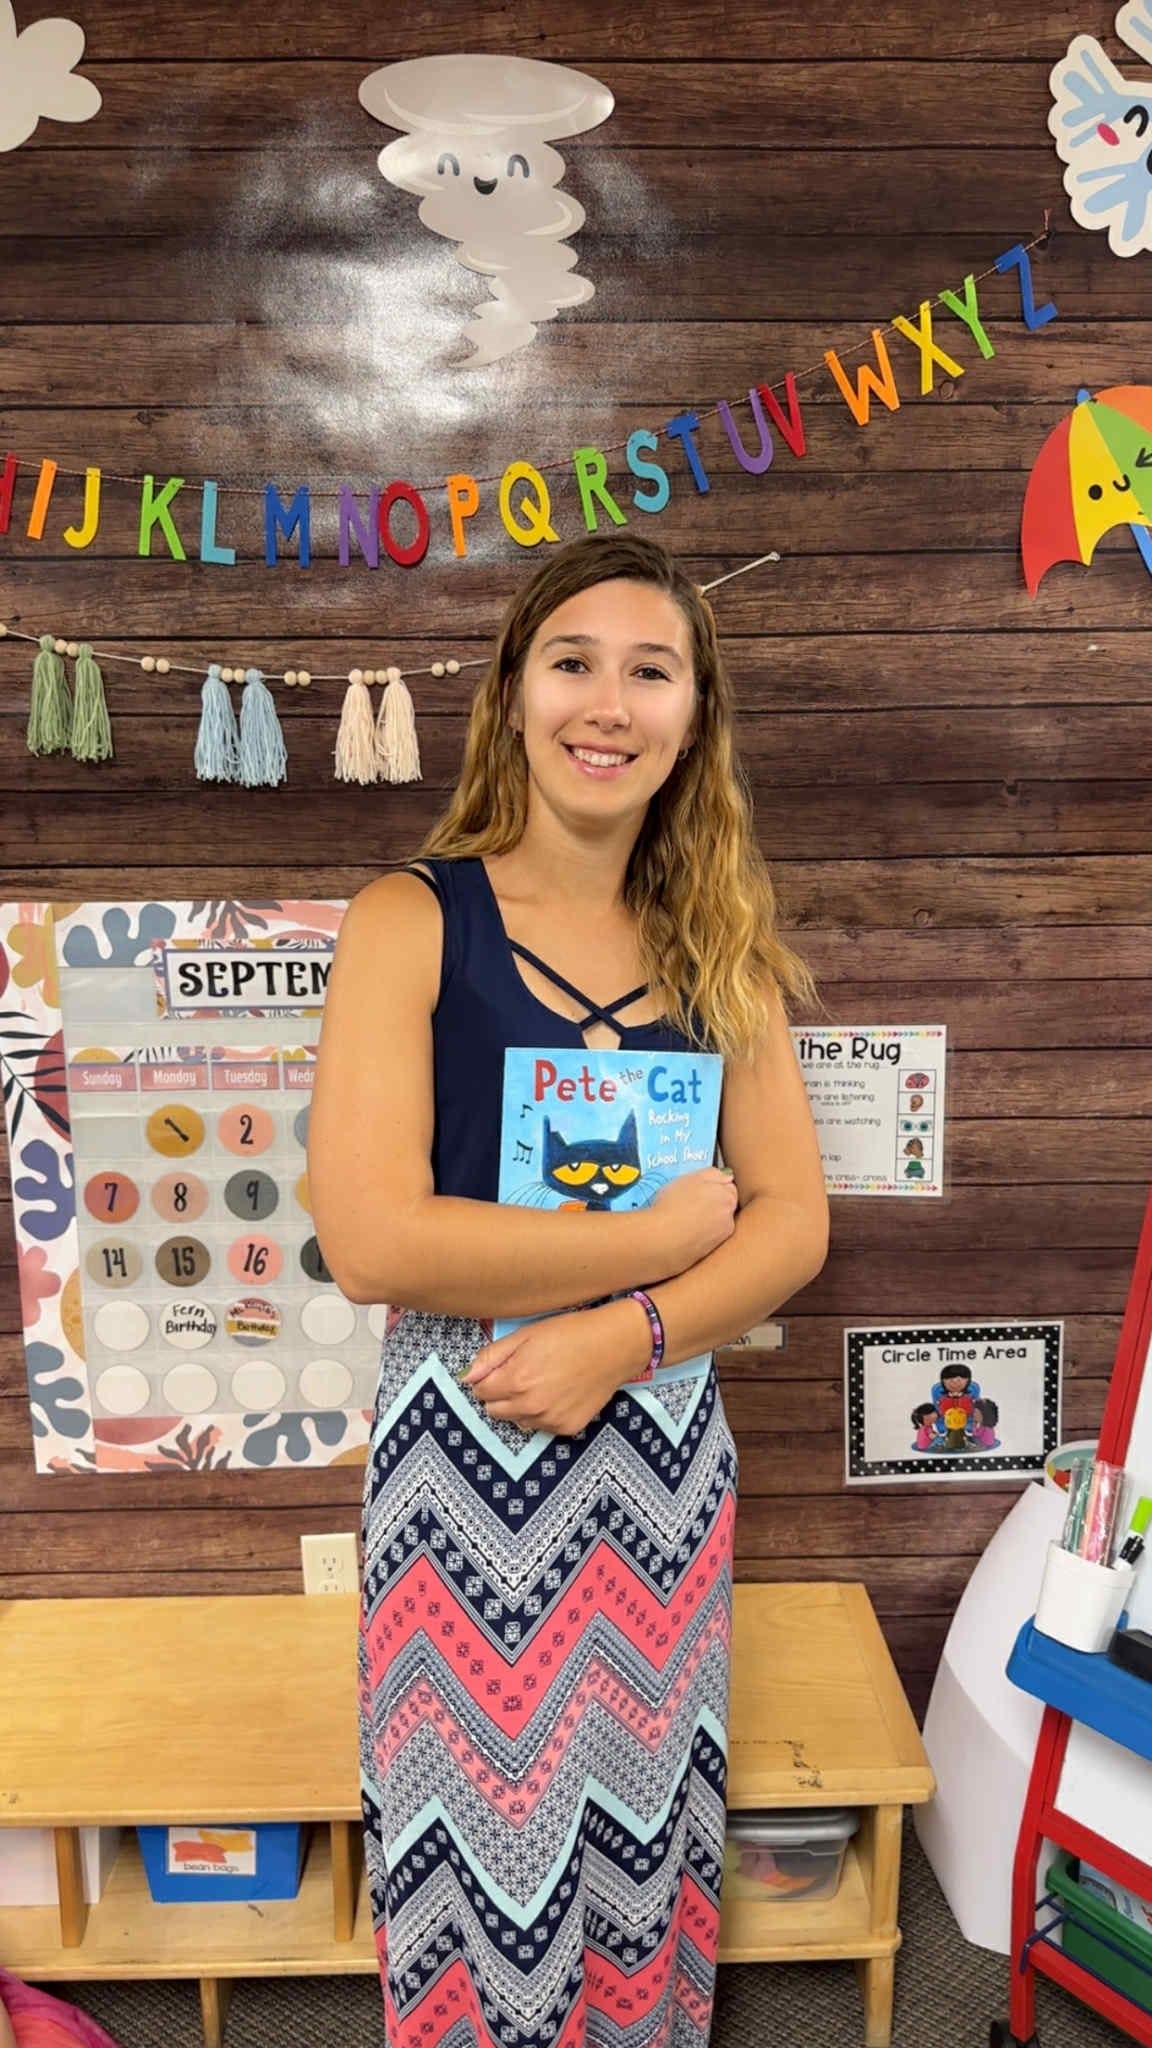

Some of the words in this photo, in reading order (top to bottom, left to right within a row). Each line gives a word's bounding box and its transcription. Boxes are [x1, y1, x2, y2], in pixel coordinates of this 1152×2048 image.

[27, 458, 57, 540] I
[64, 468, 101, 549] J
[139, 475, 186, 560] K
[202, 480, 235, 565] L
[265, 483, 310, 567] M
[339, 485, 380, 568] N
[378, 480, 430, 567] O
[447, 473, 479, 557] P
[499, 461, 560, 547] Q
[573, 447, 628, 531] R
[626, 429, 670, 514] S
[667, 413, 710, 494] T
[718, 388, 773, 475] U
[758, 372, 806, 457] V
[824, 329, 900, 426] W
[891, 301, 965, 395] X
[938, 274, 994, 360] Y
[994, 244, 1059, 331] Z
[799, 1038, 843, 1061] the
[852, 1037, 901, 1065] Rug
[846, 1061, 862, 1069] the
[82, 1071, 122, 1087] Sunday
[153, 1070, 196, 1086] Monday
[224, 1069, 268, 1086] Tuesday
[532, 1059, 618, 1103] Pete
[619, 1067, 644, 1086] the
[647, 1066, 702, 1104] Cat
[833, 1080, 866, 1089] thinking
[841, 1093, 875, 1102] listening
[648, 1108, 690, 1128] Rocking
[844, 1117, 882, 1127] watching
[164, 1118, 190, 1142] 1
[240, 1114, 253, 1145] 2
[648, 1148, 677, 1168] School
[104, 1182, 118, 1213] 7
[174, 1182, 187, 1213] 8
[246, 1181, 260, 1211] 9
[102, 1248, 128, 1278] 14
[172, 1246, 196, 1276] 15
[244, 1244, 269, 1276] 16
[172, 1304, 205, 1318] Fern
[165, 1318, 218, 1338] Birthday
[882, 1348, 931, 1363] Circle
[937, 1347, 977, 1361] Time
[984, 1345, 1027, 1359] Area
[183, 1862, 210, 1871] bean
[213, 1863, 240, 1873] bags
